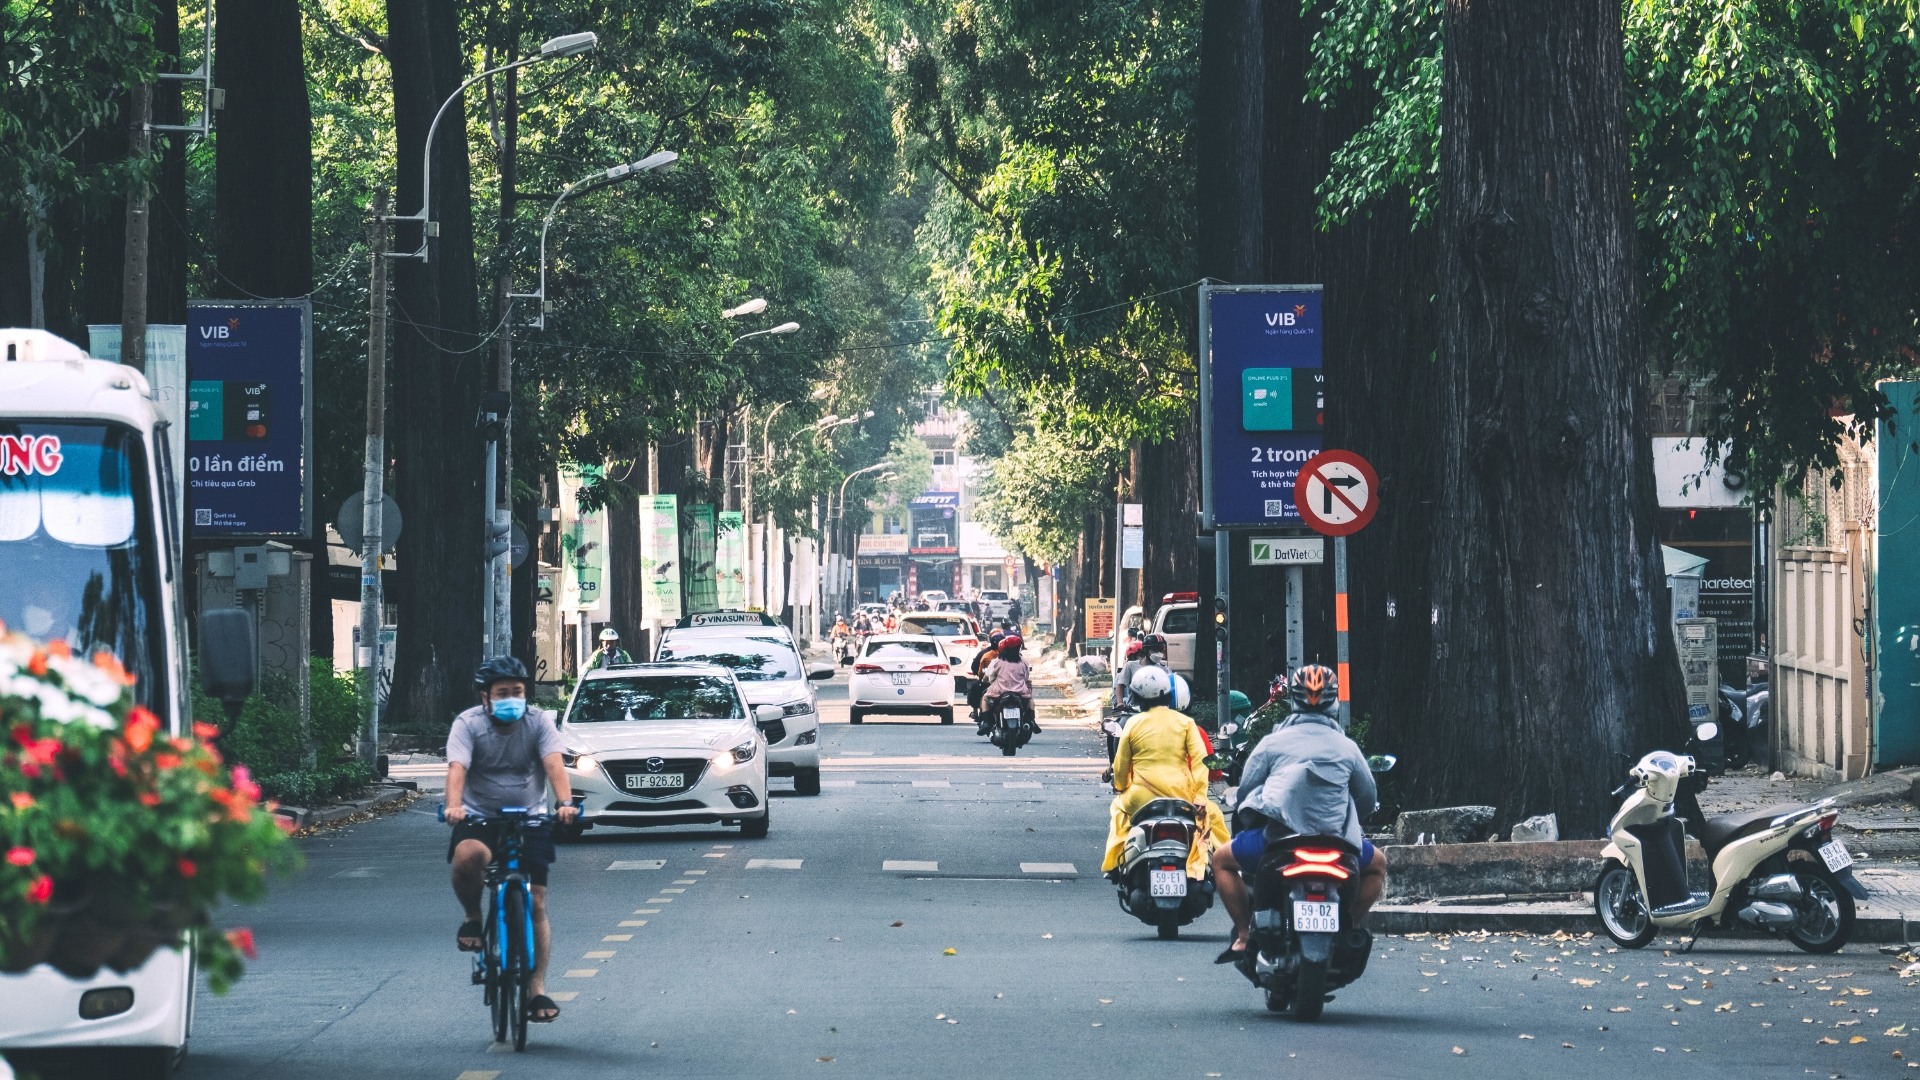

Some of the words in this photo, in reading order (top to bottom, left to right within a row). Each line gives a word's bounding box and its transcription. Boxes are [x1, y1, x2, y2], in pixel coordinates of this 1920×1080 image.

[1265, 312, 1296, 326] VIB
[200, 326, 230, 339] VIB
[244, 387, 261, 395] VIB
[0, 435, 64, 477] NG
[1251, 447, 1263, 463] 2
[189, 456, 200, 472] 0
[205, 454, 233, 472] lần
[237, 453, 284, 472] điểm
[1251, 470, 1268, 478] Tích
[1269, 470, 1285, 479] hợp
[1260, 480, 1267, 488] &
[1268, 480, 1282, 488] thẻ
[627, 775, 682, 788] 51F-926.28
[1156, 872, 1180, 883] 59-E1
[1153, 884, 1185, 895] 659.30
[1301, 904, 1332, 917] 59-D2
[1297, 917, 1336, 930] 630.08
